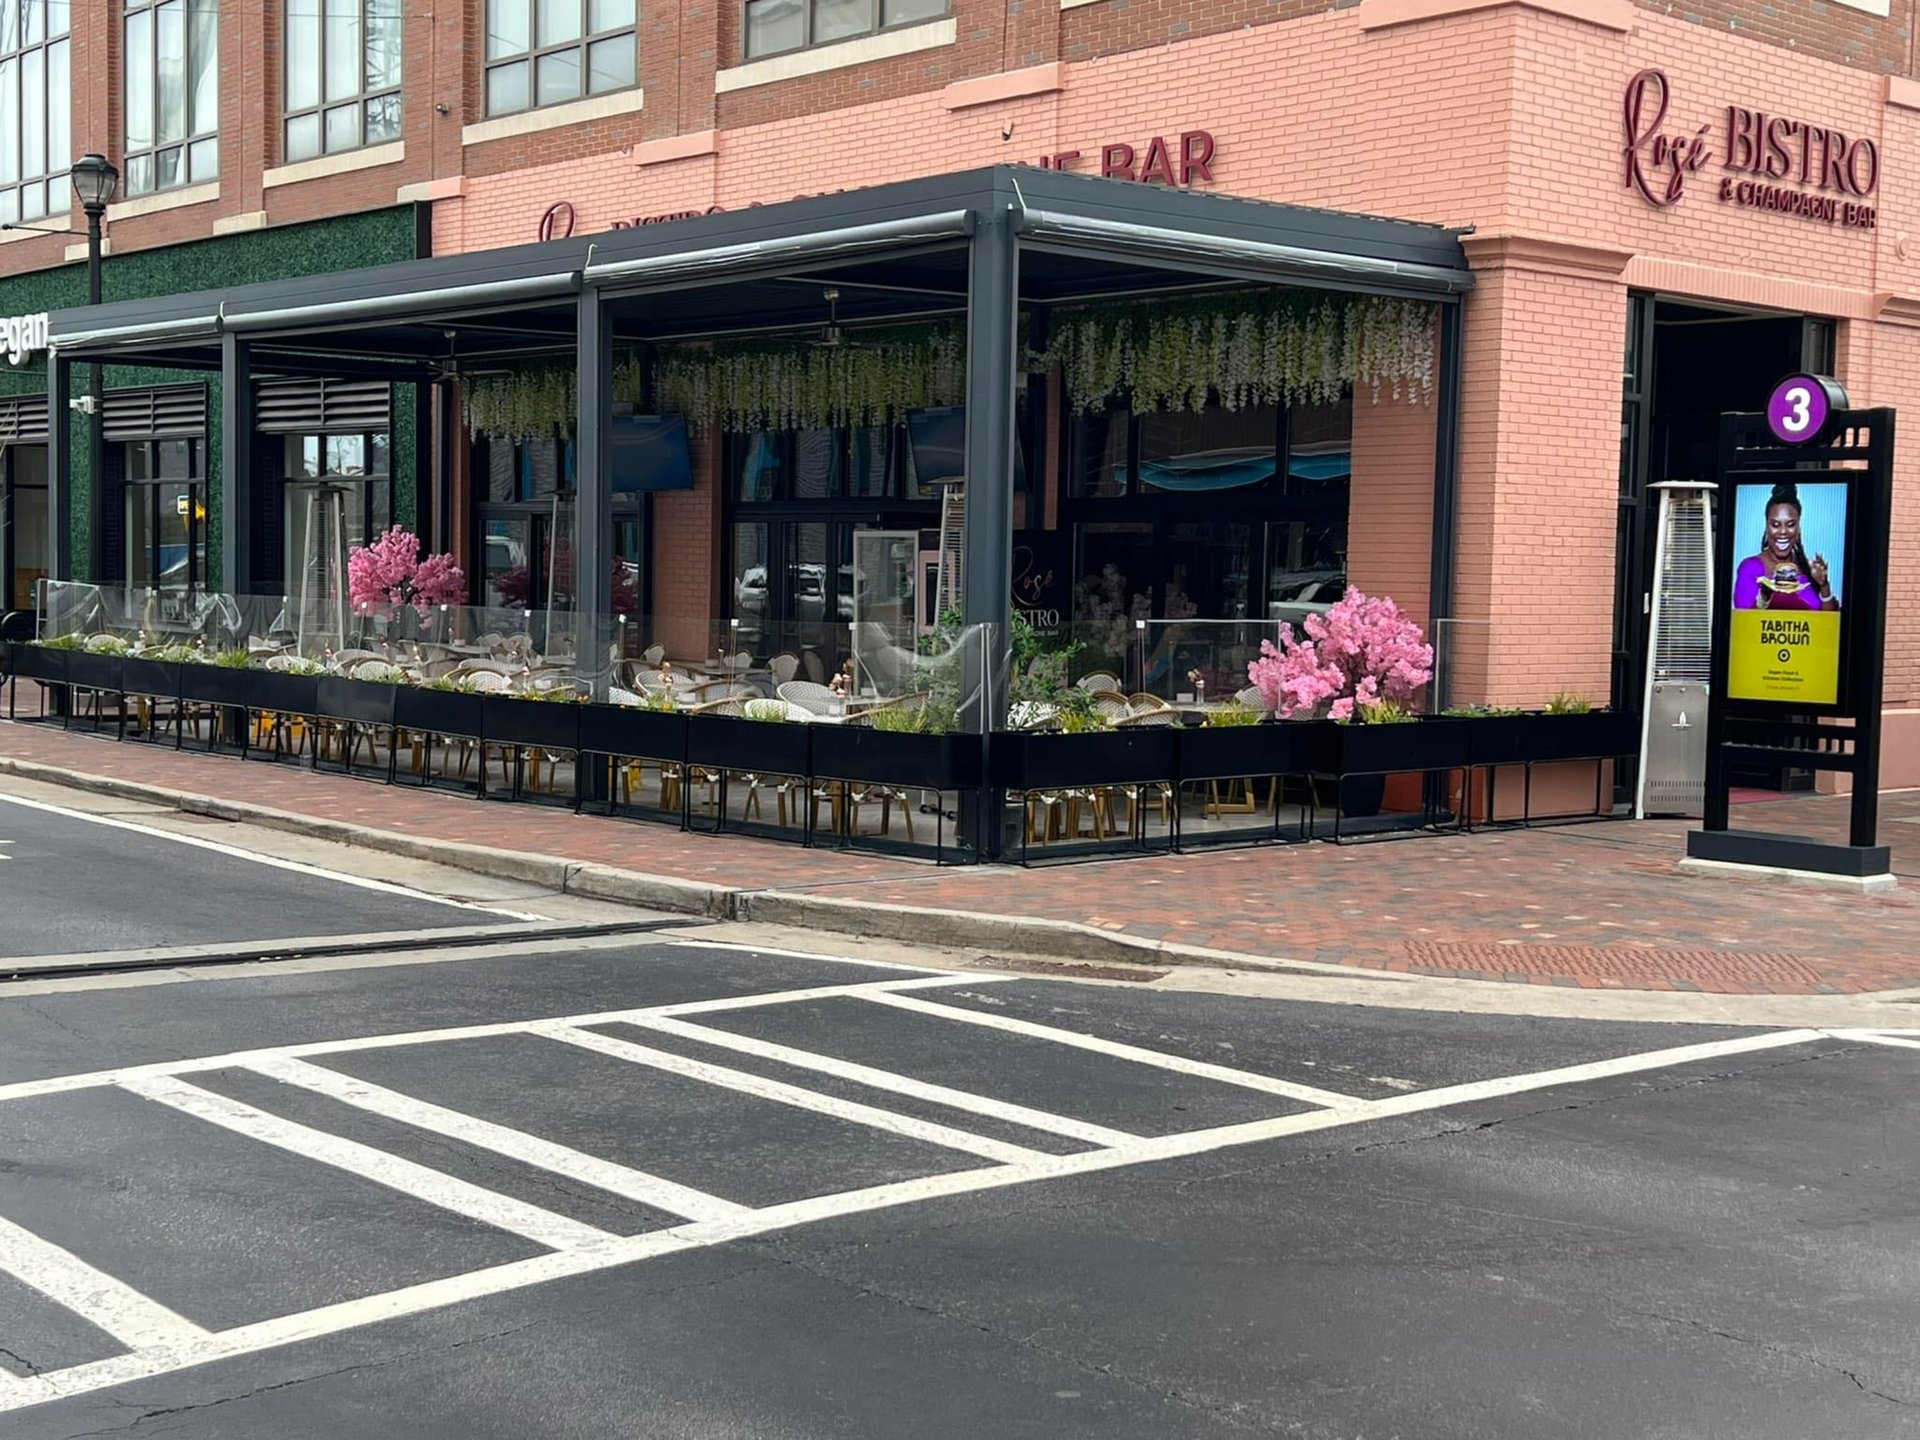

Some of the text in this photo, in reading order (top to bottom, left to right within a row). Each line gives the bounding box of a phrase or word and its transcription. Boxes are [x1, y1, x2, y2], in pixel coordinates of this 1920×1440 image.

[1101, 129, 1216, 187] BAR
[1724, 105, 1880, 198] BISTRO
[1843, 202, 1877, 228] BAR
[1782, 387, 1811, 432] 3
[1760, 619, 1810, 632] TABITHA
[1760, 633, 1810, 645] BROWN
